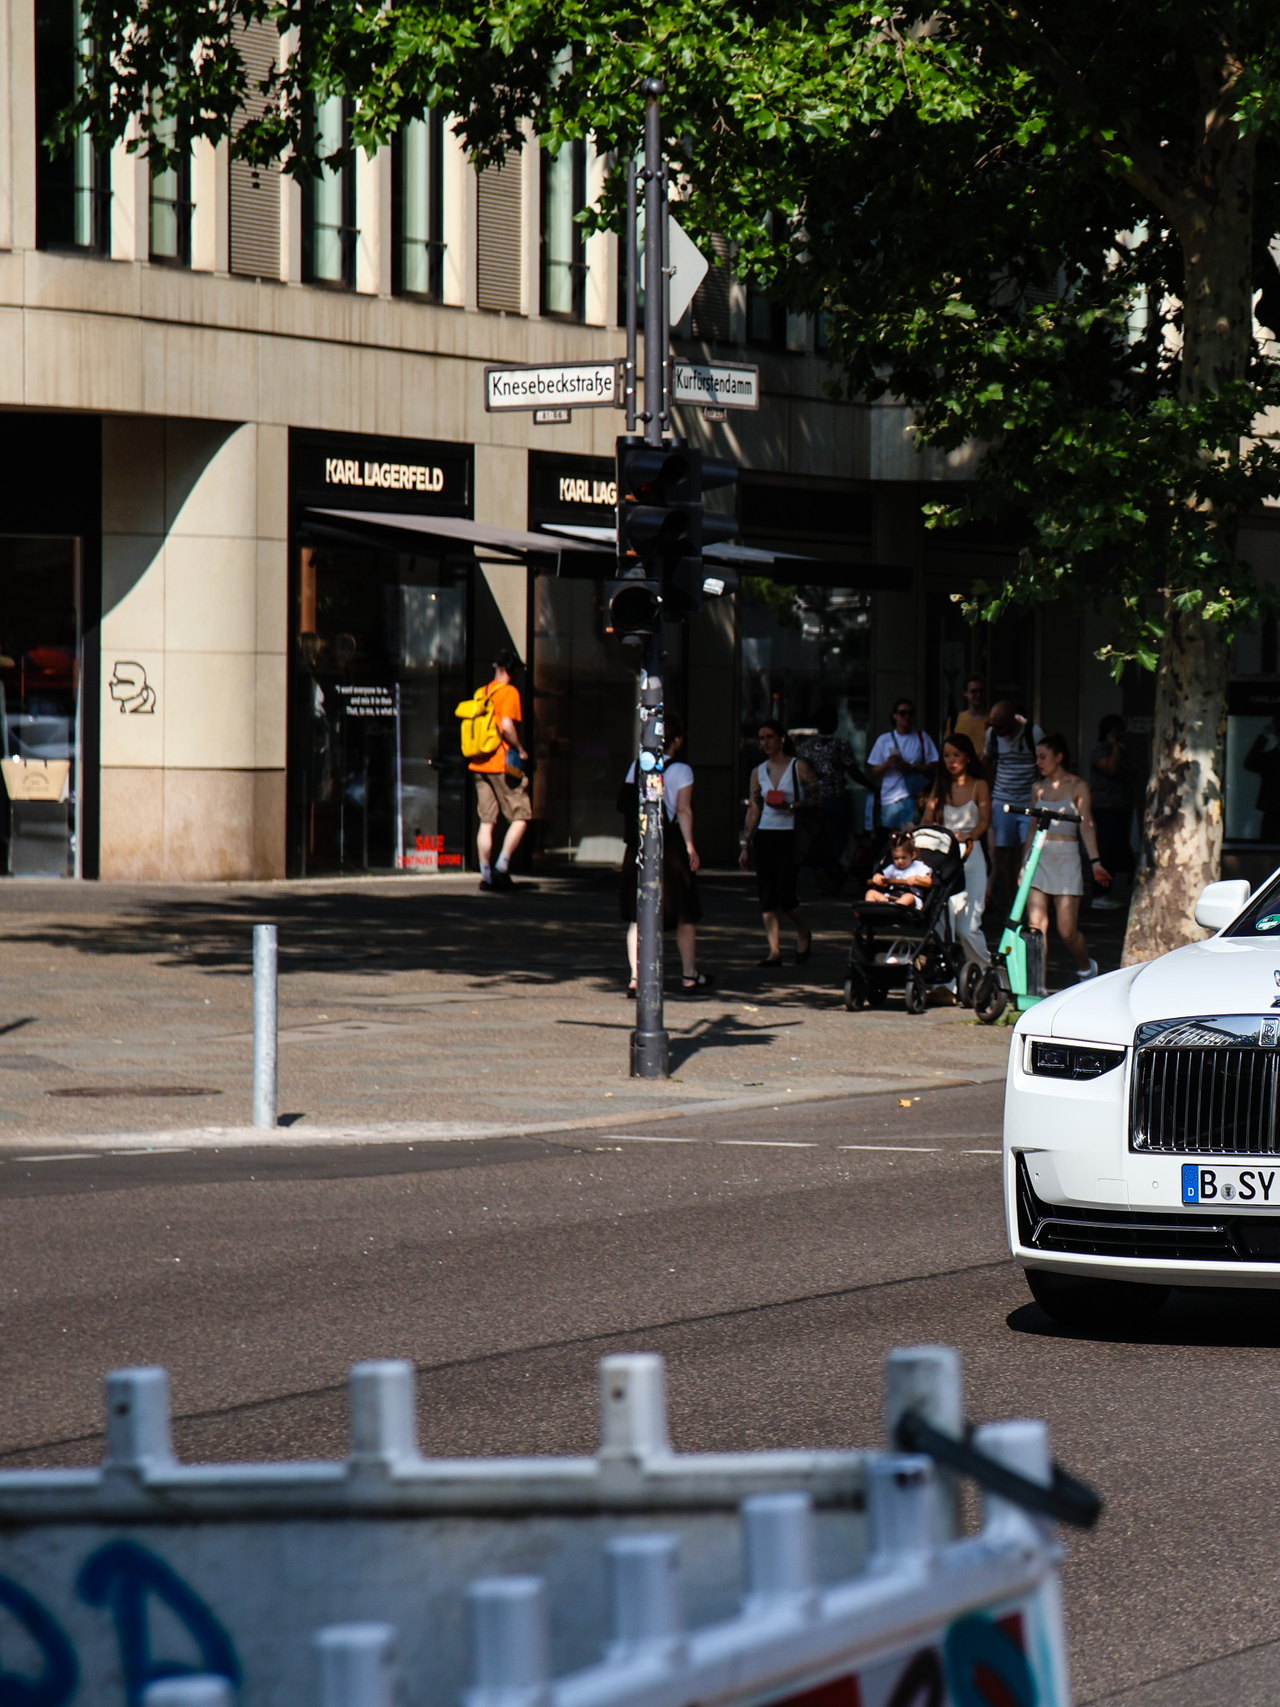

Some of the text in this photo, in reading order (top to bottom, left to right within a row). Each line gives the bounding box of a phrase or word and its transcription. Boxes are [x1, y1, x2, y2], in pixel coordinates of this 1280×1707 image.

[492, 370, 612, 397] Knesebeckstraße
[675, 368, 753, 395] Kurfürstendamm
[326, 457, 444, 492] KARL LAGERFELD
[559, 477, 592, 503] KARL
[415, 834, 445, 853] SALE
[1187, 1187, 1195, 1197] D
[1200, 1170, 1217, 1199] B
[1238, 1171, 1275, 1201] SY
